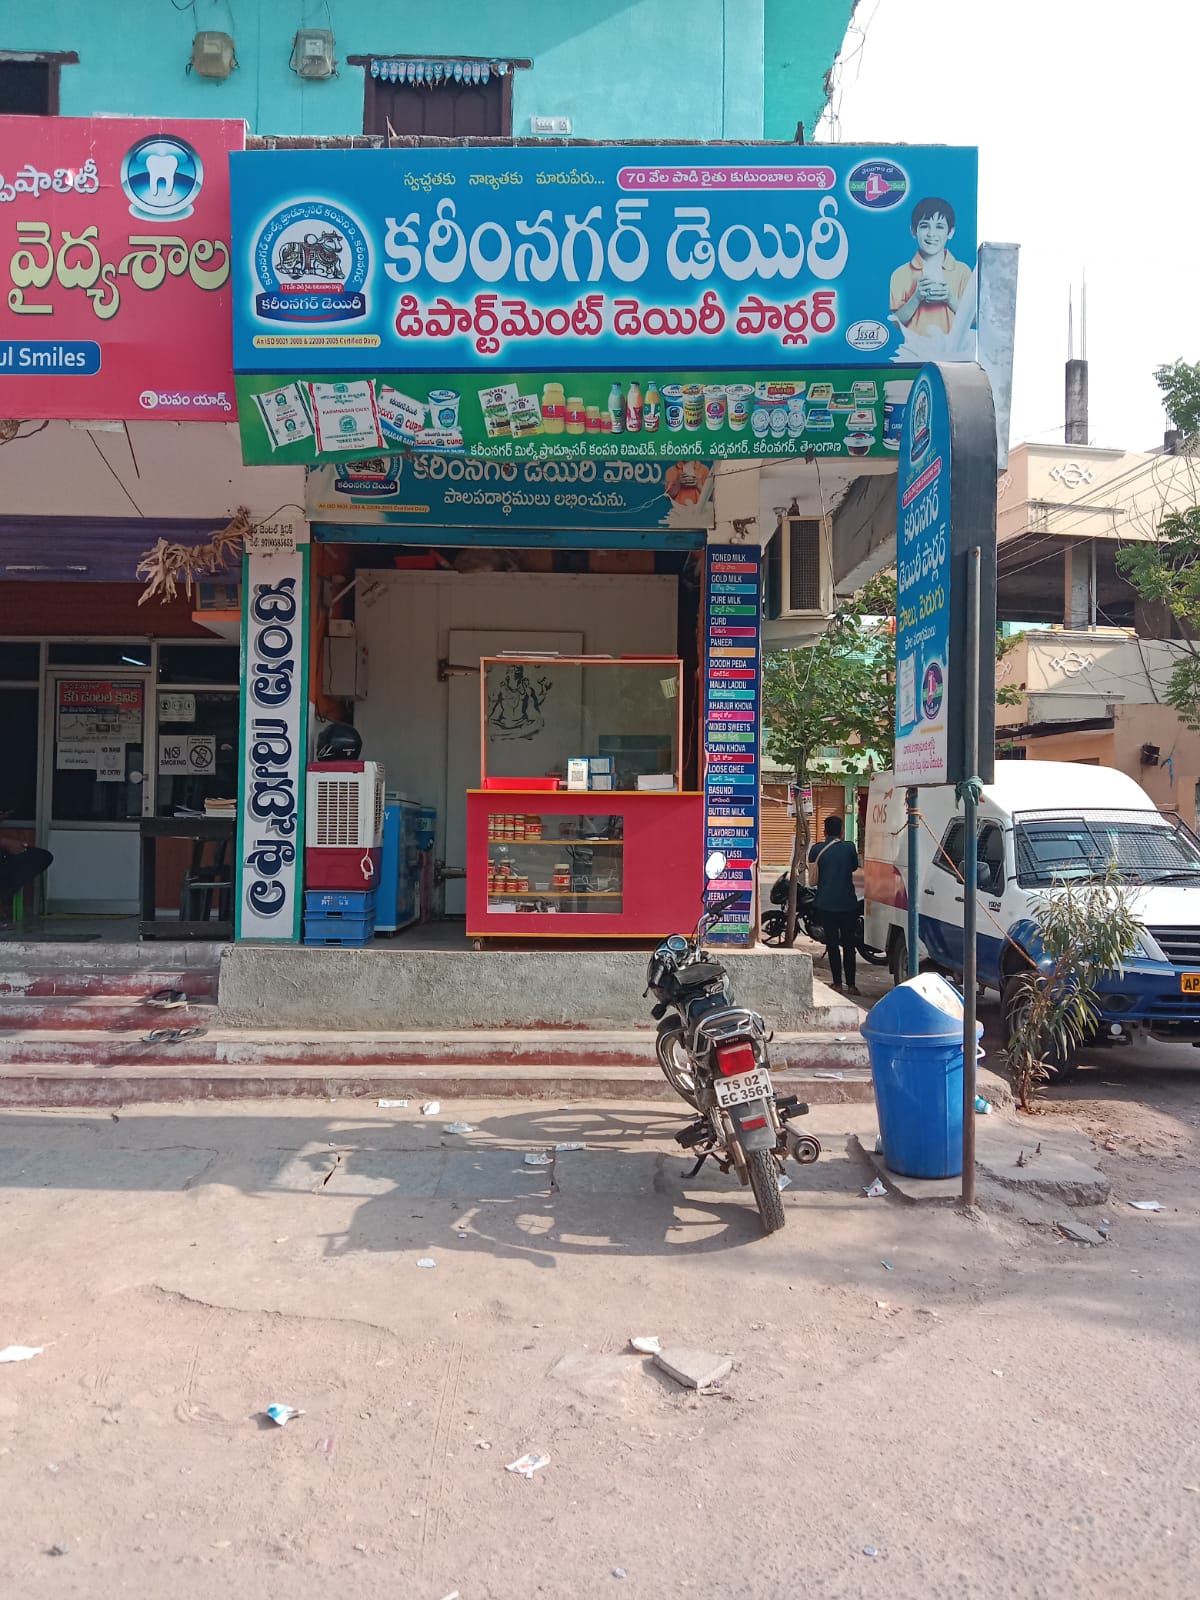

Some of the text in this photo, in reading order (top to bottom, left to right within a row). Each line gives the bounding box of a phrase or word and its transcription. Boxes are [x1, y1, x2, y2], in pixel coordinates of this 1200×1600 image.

[469, 172, 523, 190] నాణ్యతకు
[626, 170, 826, 188] 70 వేల పాడి రైతు కుటుంబాల సంస్థ
[868, 175, 882, 194] 1
[384, 195, 849, 283] కరీంనగర్ డెయిరీ
[8, 221, 230, 320] వైద్యశాల
[262, 296, 362, 310] కరీంనగర్ డెయిరీ
[614, 290, 725, 336] డెయిరీ
[736, 291, 836, 345] పార్లర్
[19, 347, 86, 367] Smiles
[470, 442, 512, 457] కరీంనగర్
[514, 442, 537, 460] మిల్క్
[903, 478, 940, 546] కరీంనగర్
[712, 553, 746, 562] TONED MILK
[711, 575, 742, 583] GOLD MILK
[710, 596, 741, 604] PURE MILK
[710, 617, 727, 625] CURD
[710, 638, 733, 646] PANEER
[710, 659, 747, 668] DOODH PEDA
[709, 680, 747, 689] MALAI LADDU
[734, 702, 752, 710] KHOVA
[708, 723, 750, 731] MIXED SWEETS
[164, 746, 180, 759] NO
[709, 744, 746, 752] PLAIN KHOVA
[708, 765, 745, 773] LOOSE GHEE
[708, 786, 733, 795] BASUNDI
[708, 807, 745, 816] BUTTER MILK
[872, 803, 888, 824] CMS
[708, 828, 749, 837] FLAVORED MILK
[727, 850, 742, 858] LASSI
[728, 871, 744, 879] LASSI
[708, 892, 724, 900] JEERA
[723, 914, 740, 922] BUTTER
[741, 914, 750, 922] MIL
[1184, 977, 1200, 991] AP
[723, 1075, 760, 1092] TS 02
[721, 1084, 770, 1106] EC 3561
